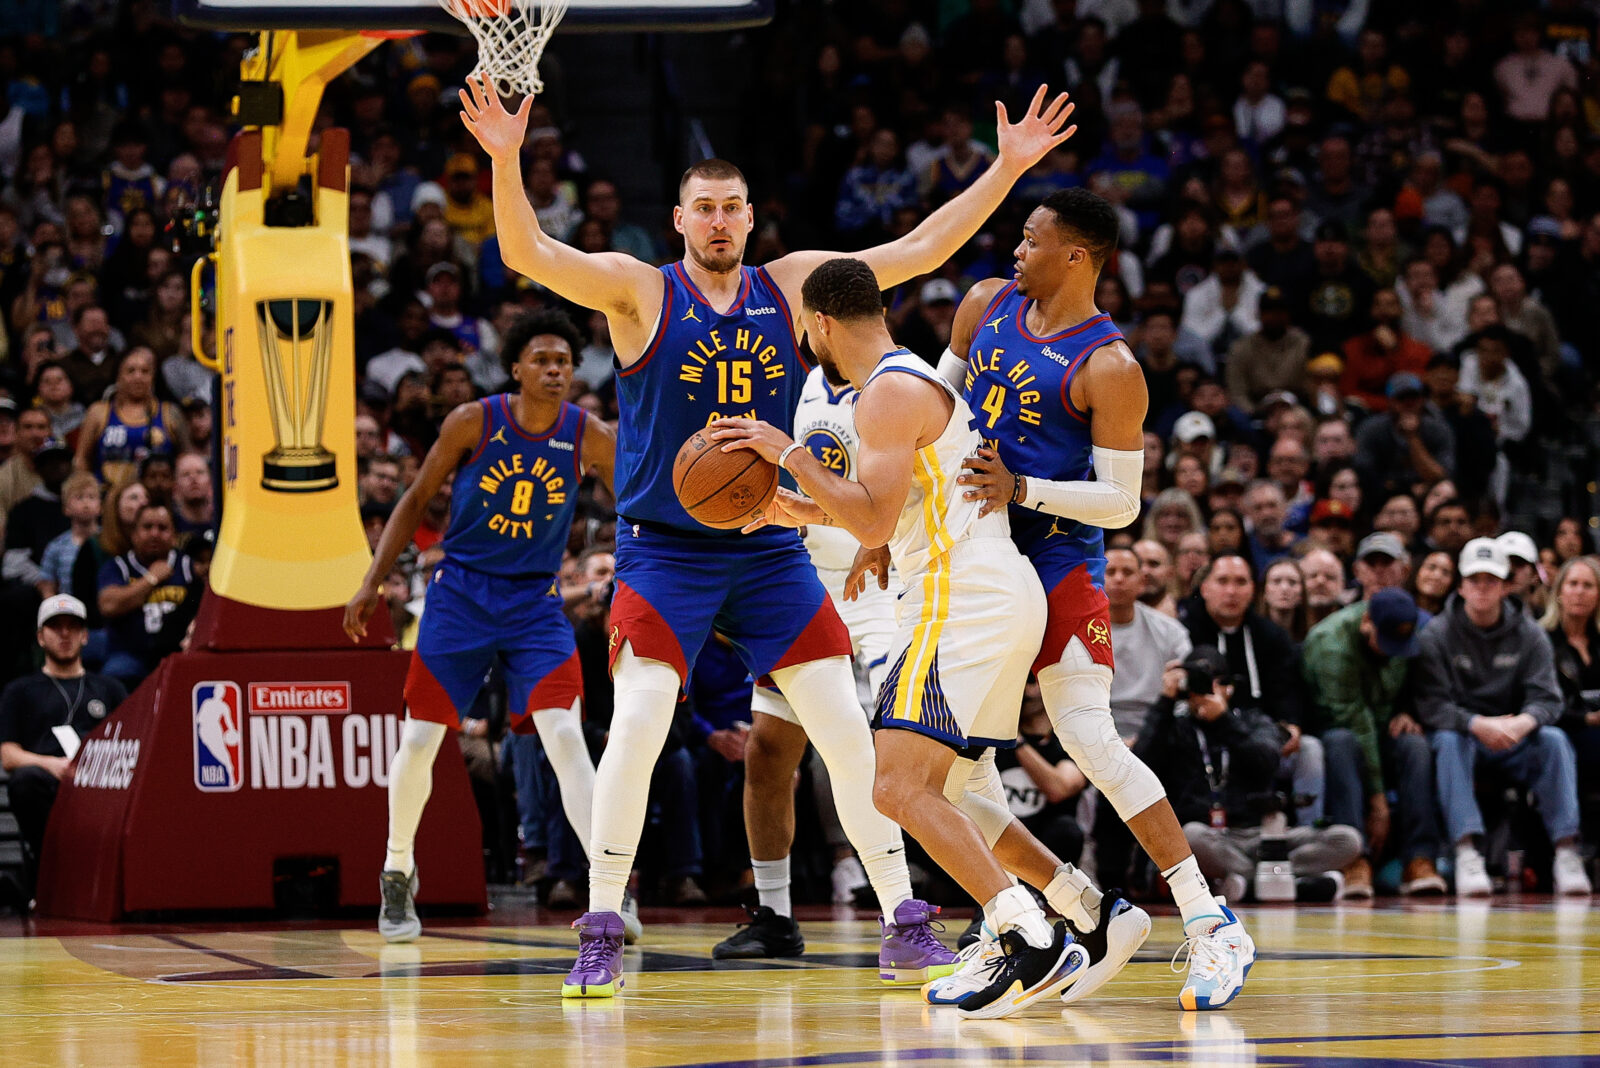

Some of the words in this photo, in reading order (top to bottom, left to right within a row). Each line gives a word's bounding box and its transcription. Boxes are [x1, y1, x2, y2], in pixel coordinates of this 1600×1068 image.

[680, 330, 727, 383] MILE
[735, 328, 785, 380] HIGH
[1041, 345, 1070, 367] ibotta
[716, 361, 752, 404] 15
[964, 348, 1005, 392] MILE
[1007, 360, 1042, 426] HIGH
[981, 384, 1007, 430] 4
[832, 422, 852, 446] STATE
[821, 447, 843, 469] 32
[479, 453, 525, 494] MILE
[531, 456, 566, 505] HIGH
[510, 480, 535, 516] 8
[488, 513, 534, 539] CITY
[256, 686, 344, 708] Emirates
[73, 720, 141, 790] coinbase
[250, 714, 336, 789] NBA
[342, 713, 405, 788] CU
[201, 765, 226, 785] NBA
